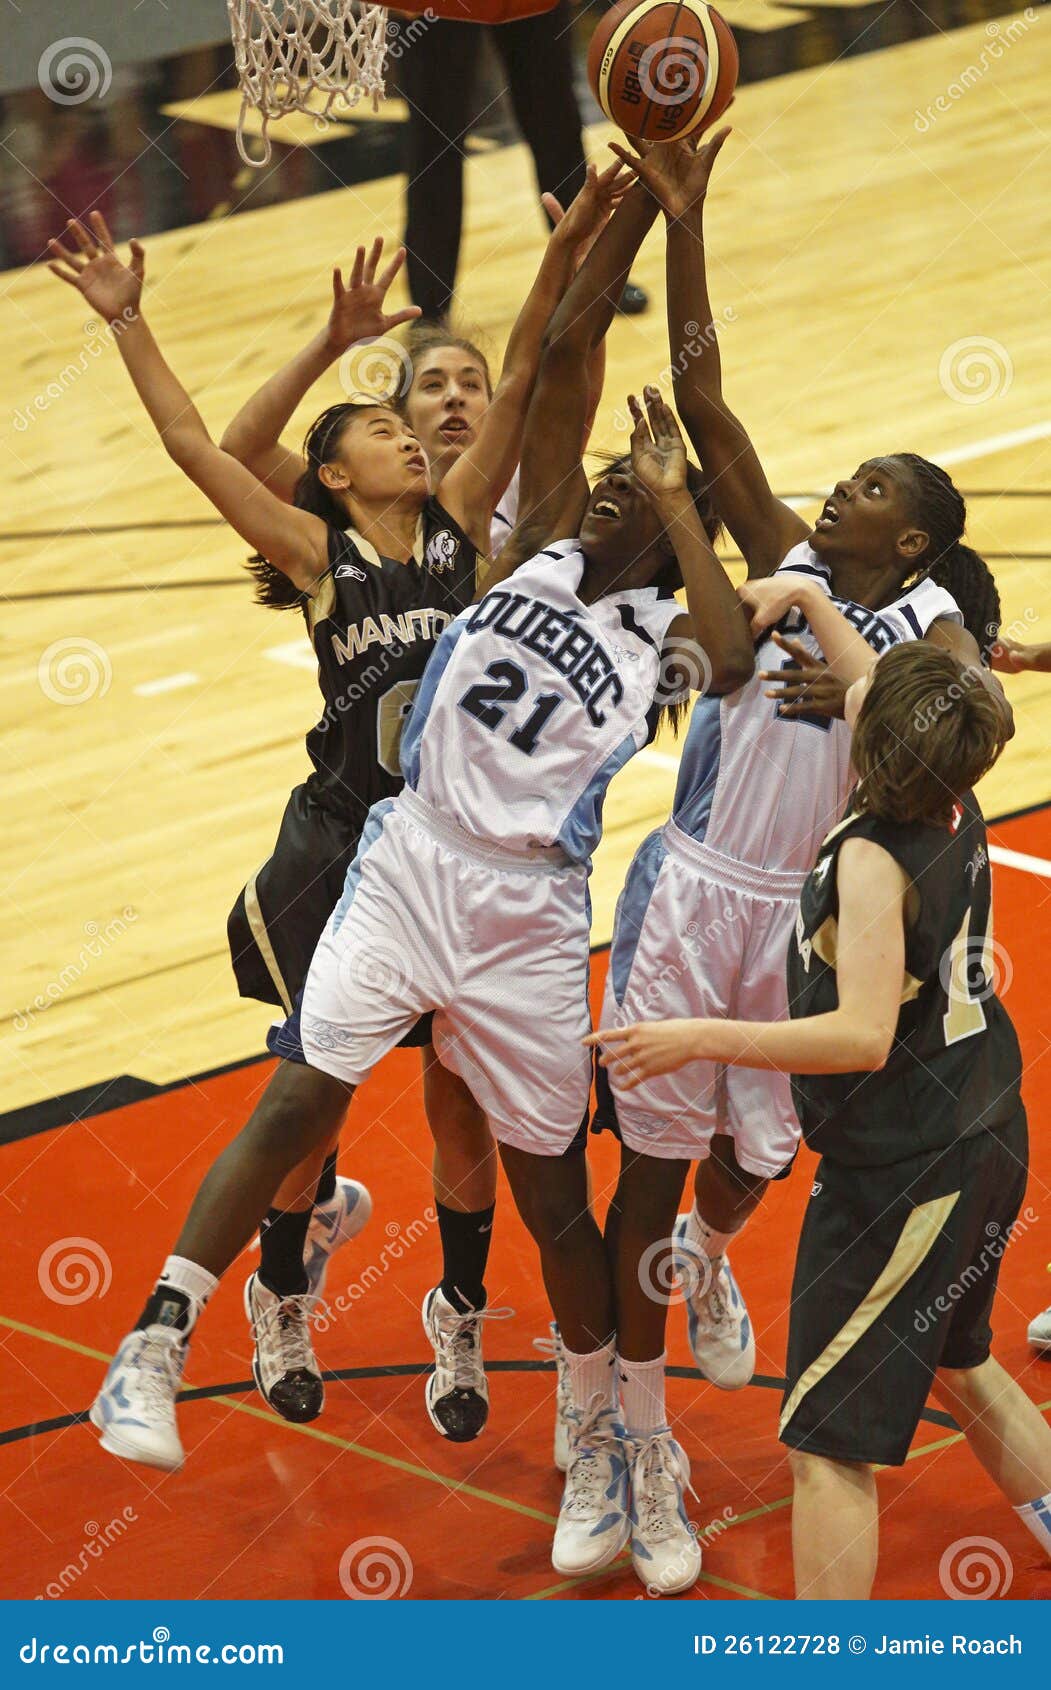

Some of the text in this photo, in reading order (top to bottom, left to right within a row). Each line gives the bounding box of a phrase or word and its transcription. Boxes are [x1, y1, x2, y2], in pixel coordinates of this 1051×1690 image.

[331, 607, 458, 666] MANITO
[465, 591, 624, 728] QUÉBEC
[457, 658, 565, 757] 21
